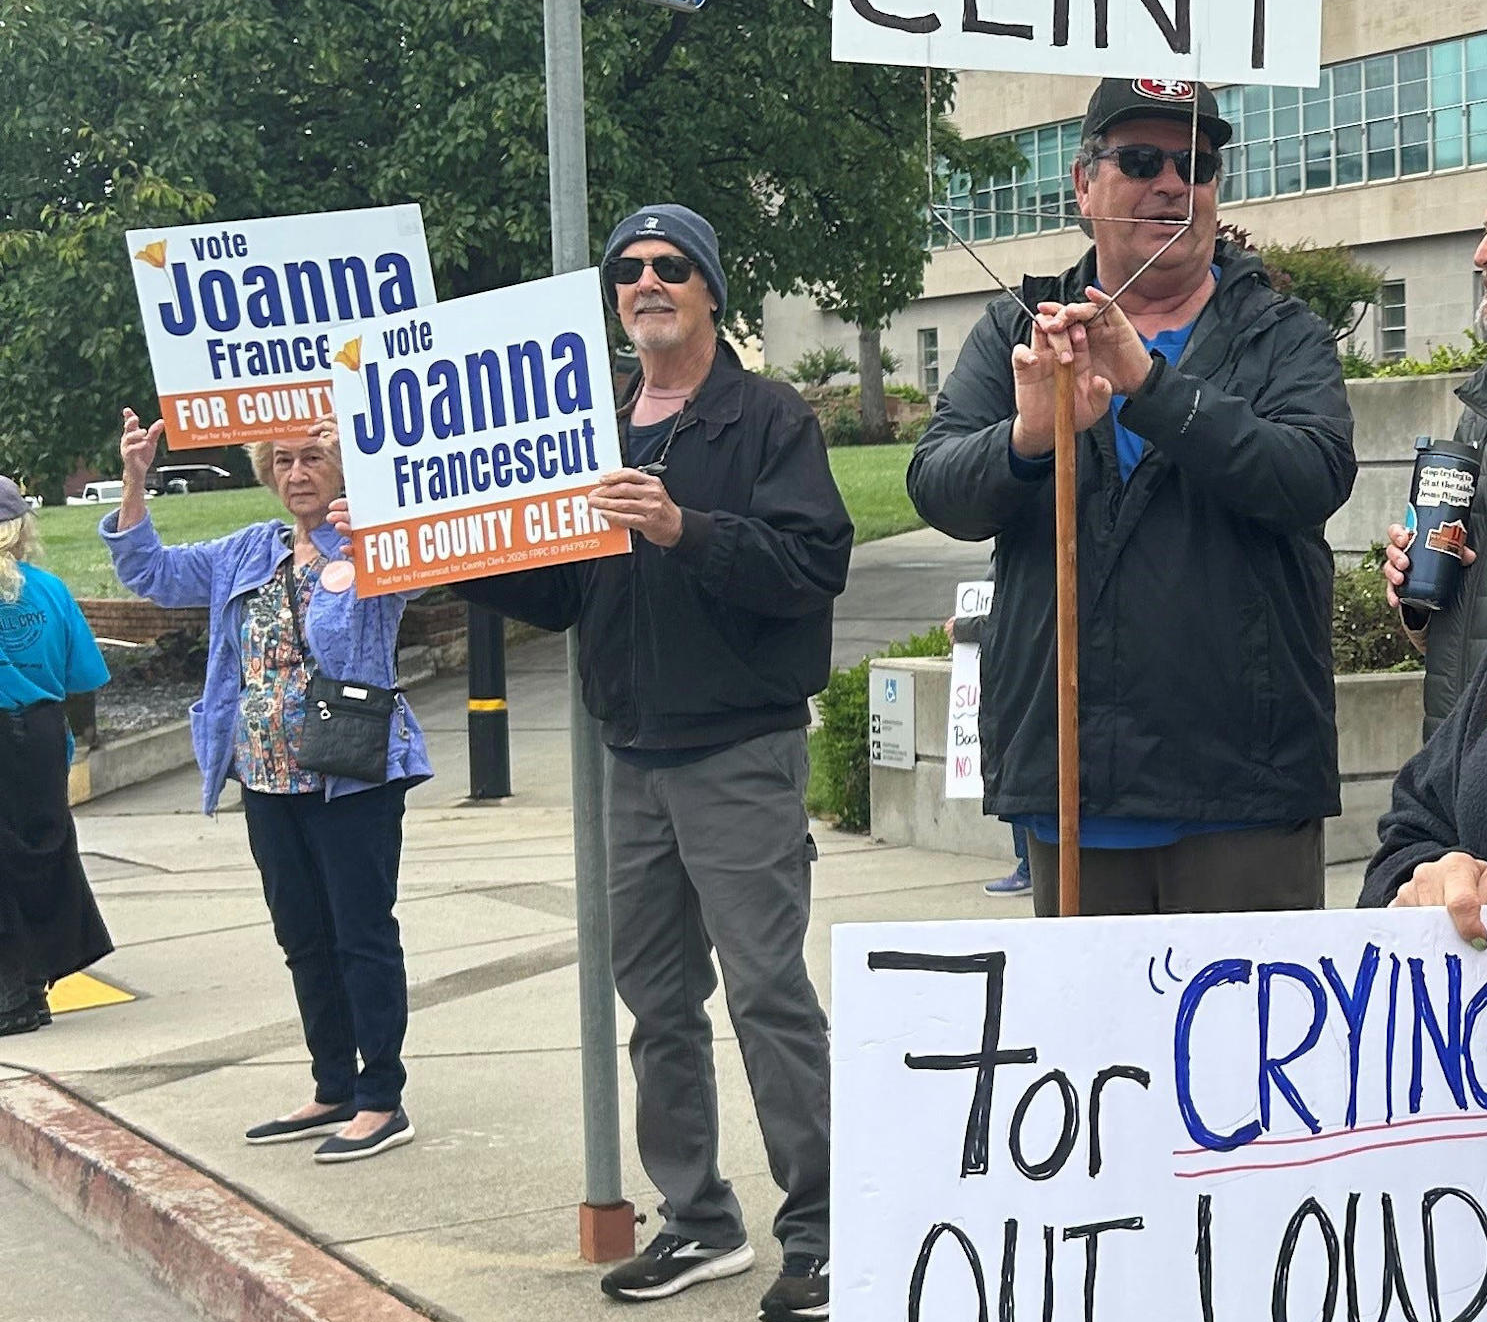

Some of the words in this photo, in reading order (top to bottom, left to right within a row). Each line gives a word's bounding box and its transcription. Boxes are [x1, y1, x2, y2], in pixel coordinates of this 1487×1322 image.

[158, 252, 418, 337] Joanna
[175, 396, 230, 431] FOR
[353, 331, 594, 456] Joanna
[393, 417, 598, 509] Francescut
[364, 528, 411, 573] FOR
[418, 508, 513, 564] COUNTY
[524, 494, 611, 545] CLERK
